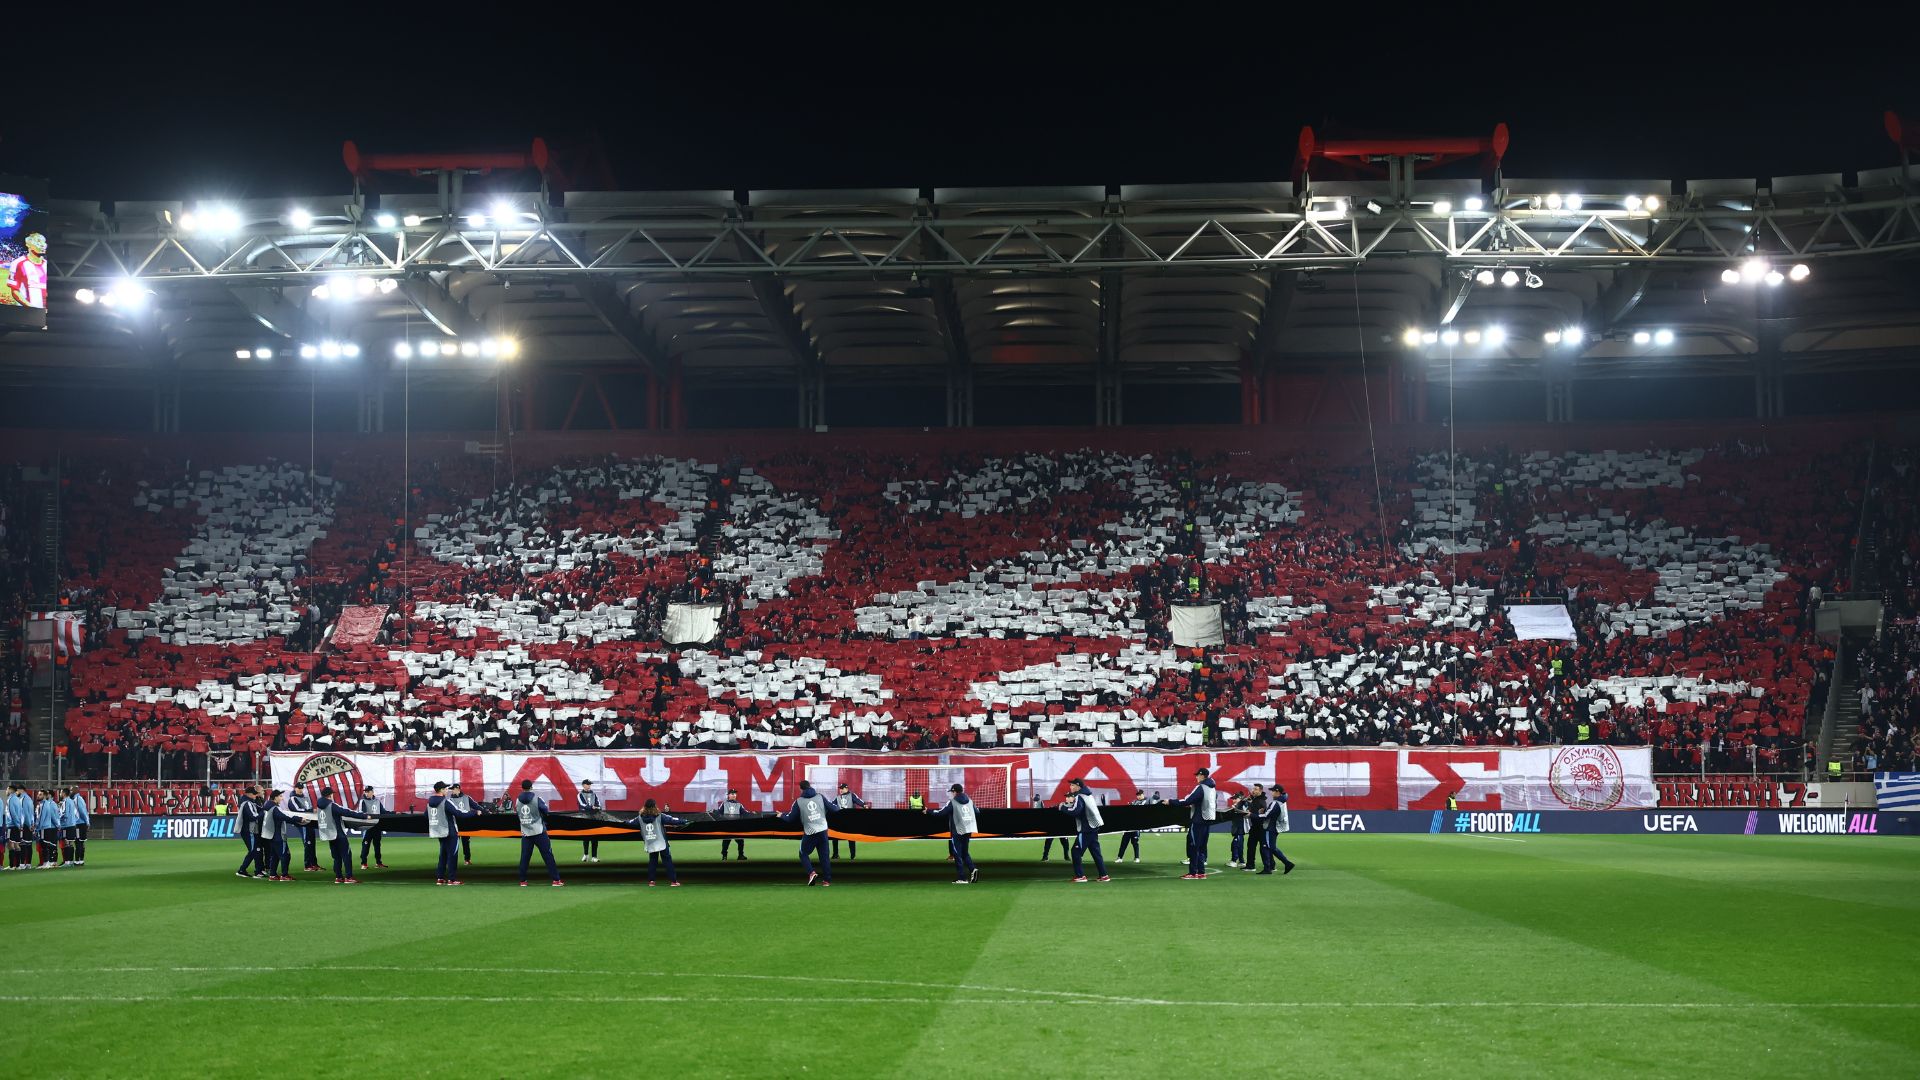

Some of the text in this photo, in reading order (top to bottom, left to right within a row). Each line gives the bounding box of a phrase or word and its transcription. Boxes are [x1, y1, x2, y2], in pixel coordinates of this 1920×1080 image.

[300, 756, 348, 782] ΟΛΥΜΠΙΑΚΟΣ
[1563, 747, 1617, 776] ΟΛΥΜΠΙΑΚΟΣ
[1657, 783, 1781, 808] BRAHAMI
[152, 819, 235, 838] #FOOTBALL
[1312, 814, 1365, 831] UEFA
[1454, 813, 1541, 832] #FOOTBALL
[1643, 814, 1698, 831] UEFA
[1779, 814, 1878, 832] WELCOME ALL
